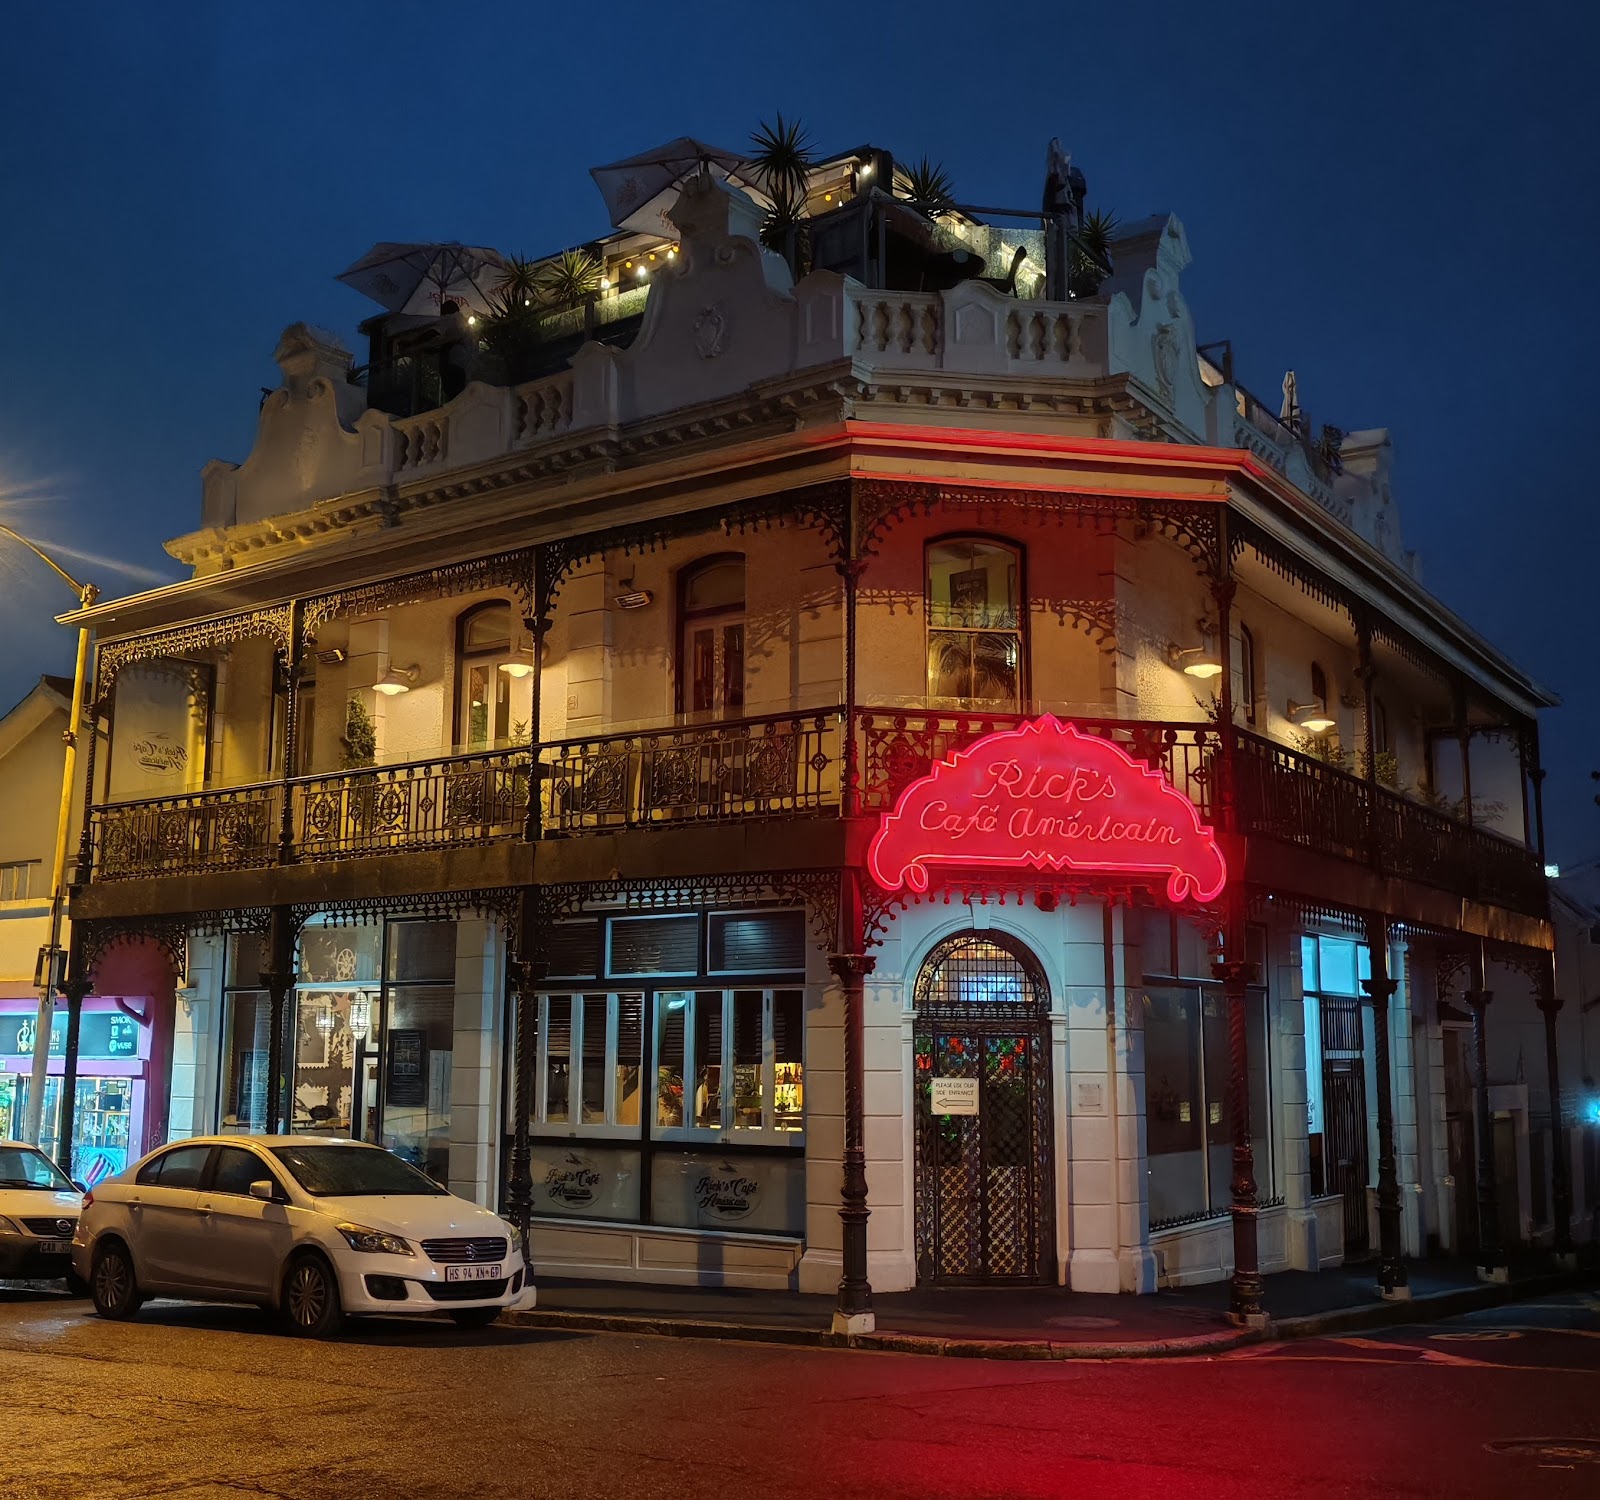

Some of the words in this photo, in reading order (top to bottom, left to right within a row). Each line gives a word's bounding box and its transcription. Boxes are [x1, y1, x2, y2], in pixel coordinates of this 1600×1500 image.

[972, 759, 1116, 804] Rick's
[919, 800, 1000, 840] Café
[695, 1176, 730, 1194] Rick's
[730, 1177, 758, 1197] Café
[449, 1268, 459, 1280] HS
[463, 1267, 472, 1279] 94
[475, 1267, 485, 1279] XN
[490, 1266, 500, 1278] GP
